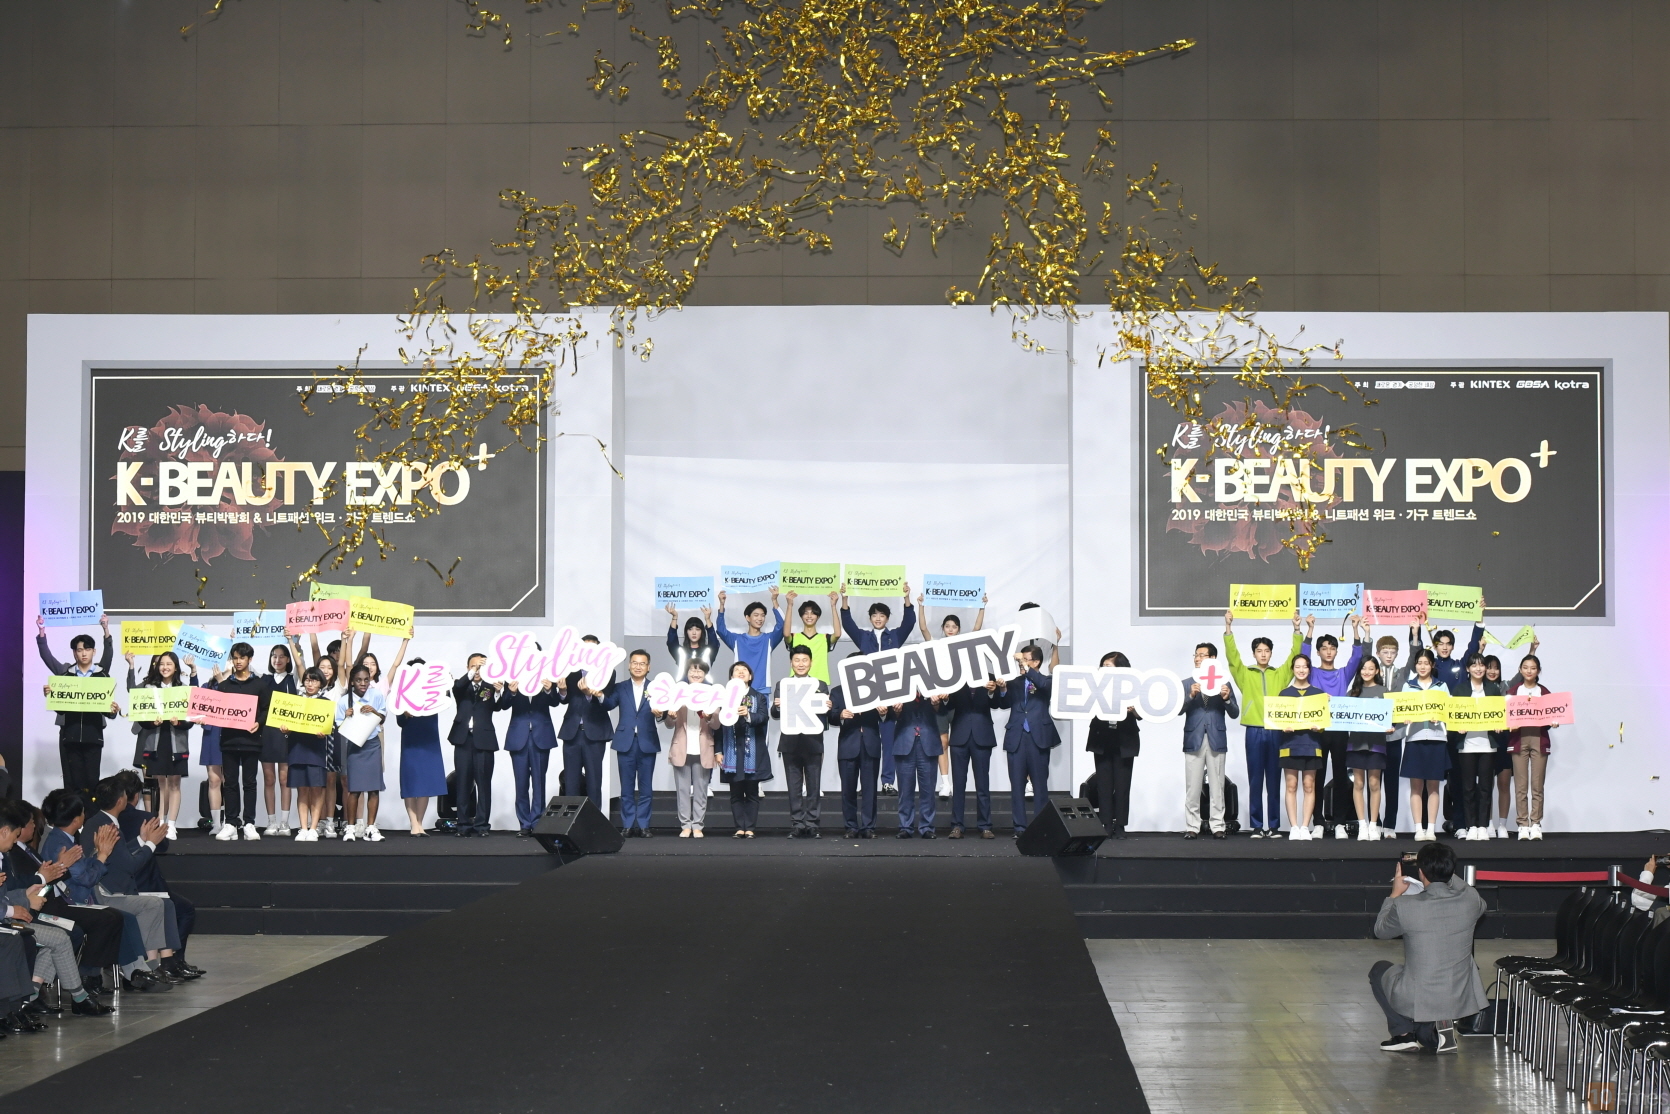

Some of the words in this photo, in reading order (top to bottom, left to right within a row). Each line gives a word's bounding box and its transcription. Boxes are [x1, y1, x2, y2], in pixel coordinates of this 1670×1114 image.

[410, 383, 451, 393] KINTEX
[1470, 380, 1511, 389] KINTEX
[1516, 380, 1550, 389] GBSA
[1554, 379, 1590, 390] kotra
[117, 427, 149, 453] K를
[117, 461, 337, 507] K-BEAUTY
[1171, 458, 1397, 503] K-BEAUTY
[117, 511, 145, 524] 2019
[149, 511, 192, 525] 대한민국
[195, 511, 250, 525] 뷰티박람회
[253, 512, 263, 524] &
[266, 511, 309, 525] 니트패션
[315, 511, 336, 525] 위크
[371, 511, 416, 525] 트렌드쇼
[1171, 509, 1201, 521] 2019
[1205, 508, 1249, 522] 대한민국
[1325, 508, 1369, 522] 니트패션
[1373, 508, 1396, 522] 위크
[1406, 508, 1429, 522] 가구
[1432, 508, 1478, 522] 트렌드쇼
[724, 577, 757, 585] K-BEAUTY
[782, 576, 814, 585] K-BEAUTY
[847, 577, 879, 587] K-BEAUTY
[657, 590, 688, 599] K-BEAUTY
[925, 588, 958, 597] K-BEAUTY
[1233, 599, 1268, 608] K-BEAUTY
[1302, 598, 1337, 607] K-BEAUTY
[42, 606, 76, 616] K-BEAUTY
[1366, 604, 1400, 614] K-BEAUTY
[289, 614, 323, 624] K-BEAUTY
[351, 610, 385, 624] K-BEAUTY
[124, 636, 158, 645] K-BEAUTY
[177, 638, 210, 656] K-BEAUTY
[487, 628, 620, 693] Styling
[844, 630, 1015, 707] BEAUTY
[50, 690, 86, 700] K-BEAUTY
[653, 679, 740, 719] 하다!
[1057, 671, 1178, 717] EXPO
[191, 702, 227, 716] K-BEAUTY
[786, 684, 823, 728] K-
[272, 707, 306, 721] K-BEAUTY
[1268, 711, 1302, 719] K-BEAUTY
[1330, 712, 1364, 721] K-BEAUTY
[1448, 711, 1481, 720] K-BEAUTY
[1509, 708, 1543, 716] K-BEAUTY
